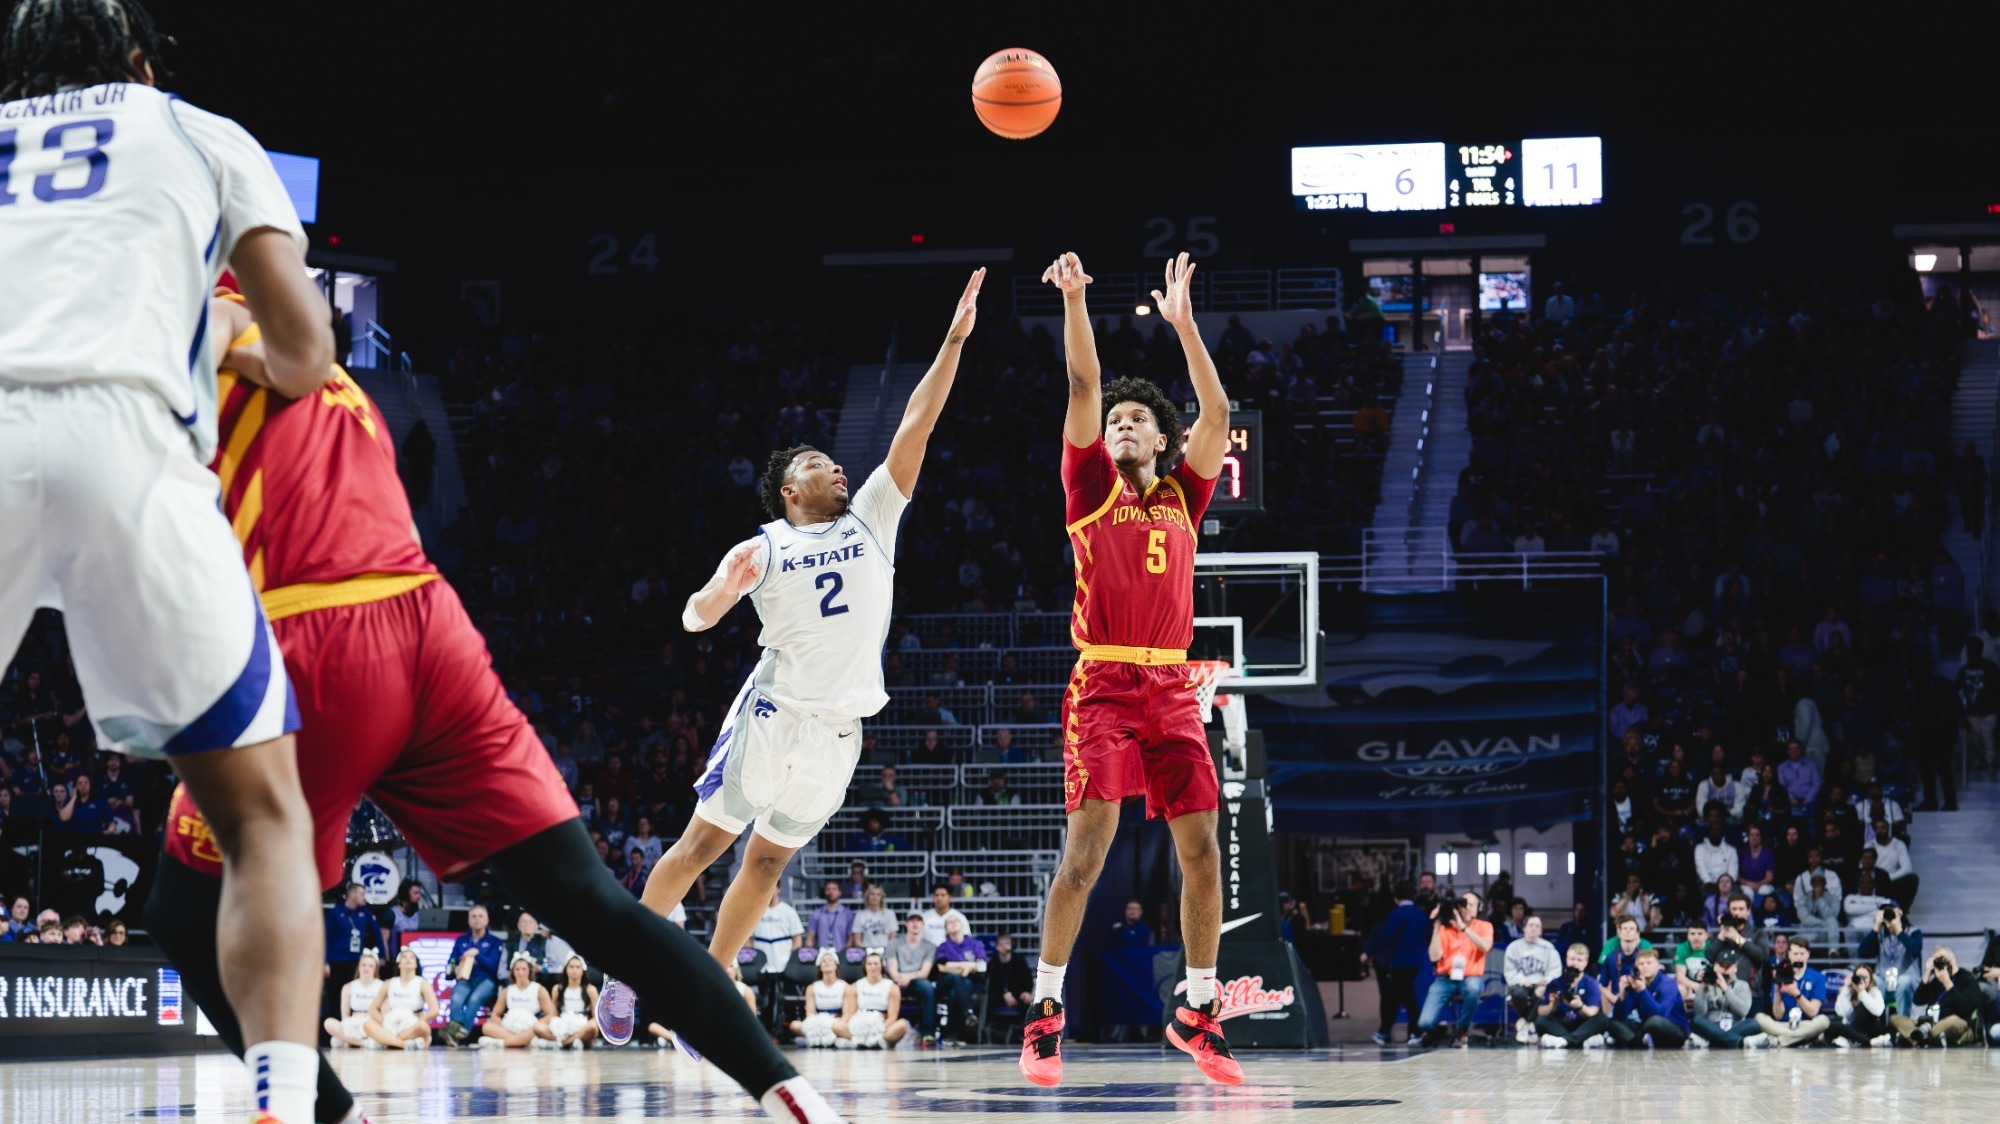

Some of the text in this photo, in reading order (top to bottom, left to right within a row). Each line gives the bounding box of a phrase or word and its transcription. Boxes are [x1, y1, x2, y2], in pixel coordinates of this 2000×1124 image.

[0, 83, 127, 119] CNAIR JR
[0, 118, 115, 206] 13
[1459, 145, 1505, 165] 11:54
[1396, 168, 1415, 195] 6
[1450, 179, 1460, 192] 4
[1504, 177, 1515, 190] 4
[1543, 163, 1577, 189] 11
[1305, 195, 1338, 210] 1:22
[1339, 193, 1364, 208] PM
[1450, 193, 1460, 207] 2
[1505, 191, 1515, 205] 2
[1143, 216, 1220, 258] 25
[1681, 201, 1760, 245] 26
[587, 232, 661, 275] 24
[1112, 504, 1187, 532] IOWA STATE
[782, 542, 865, 573] K-STATE
[1146, 529, 1168, 574] 5
[815, 571, 850, 618] 2
[1356, 734, 1561, 763] GLAVAN
[1227, 802, 1241, 910] WILDCATS
[15, 976, 148, 1018] INSURANCE
